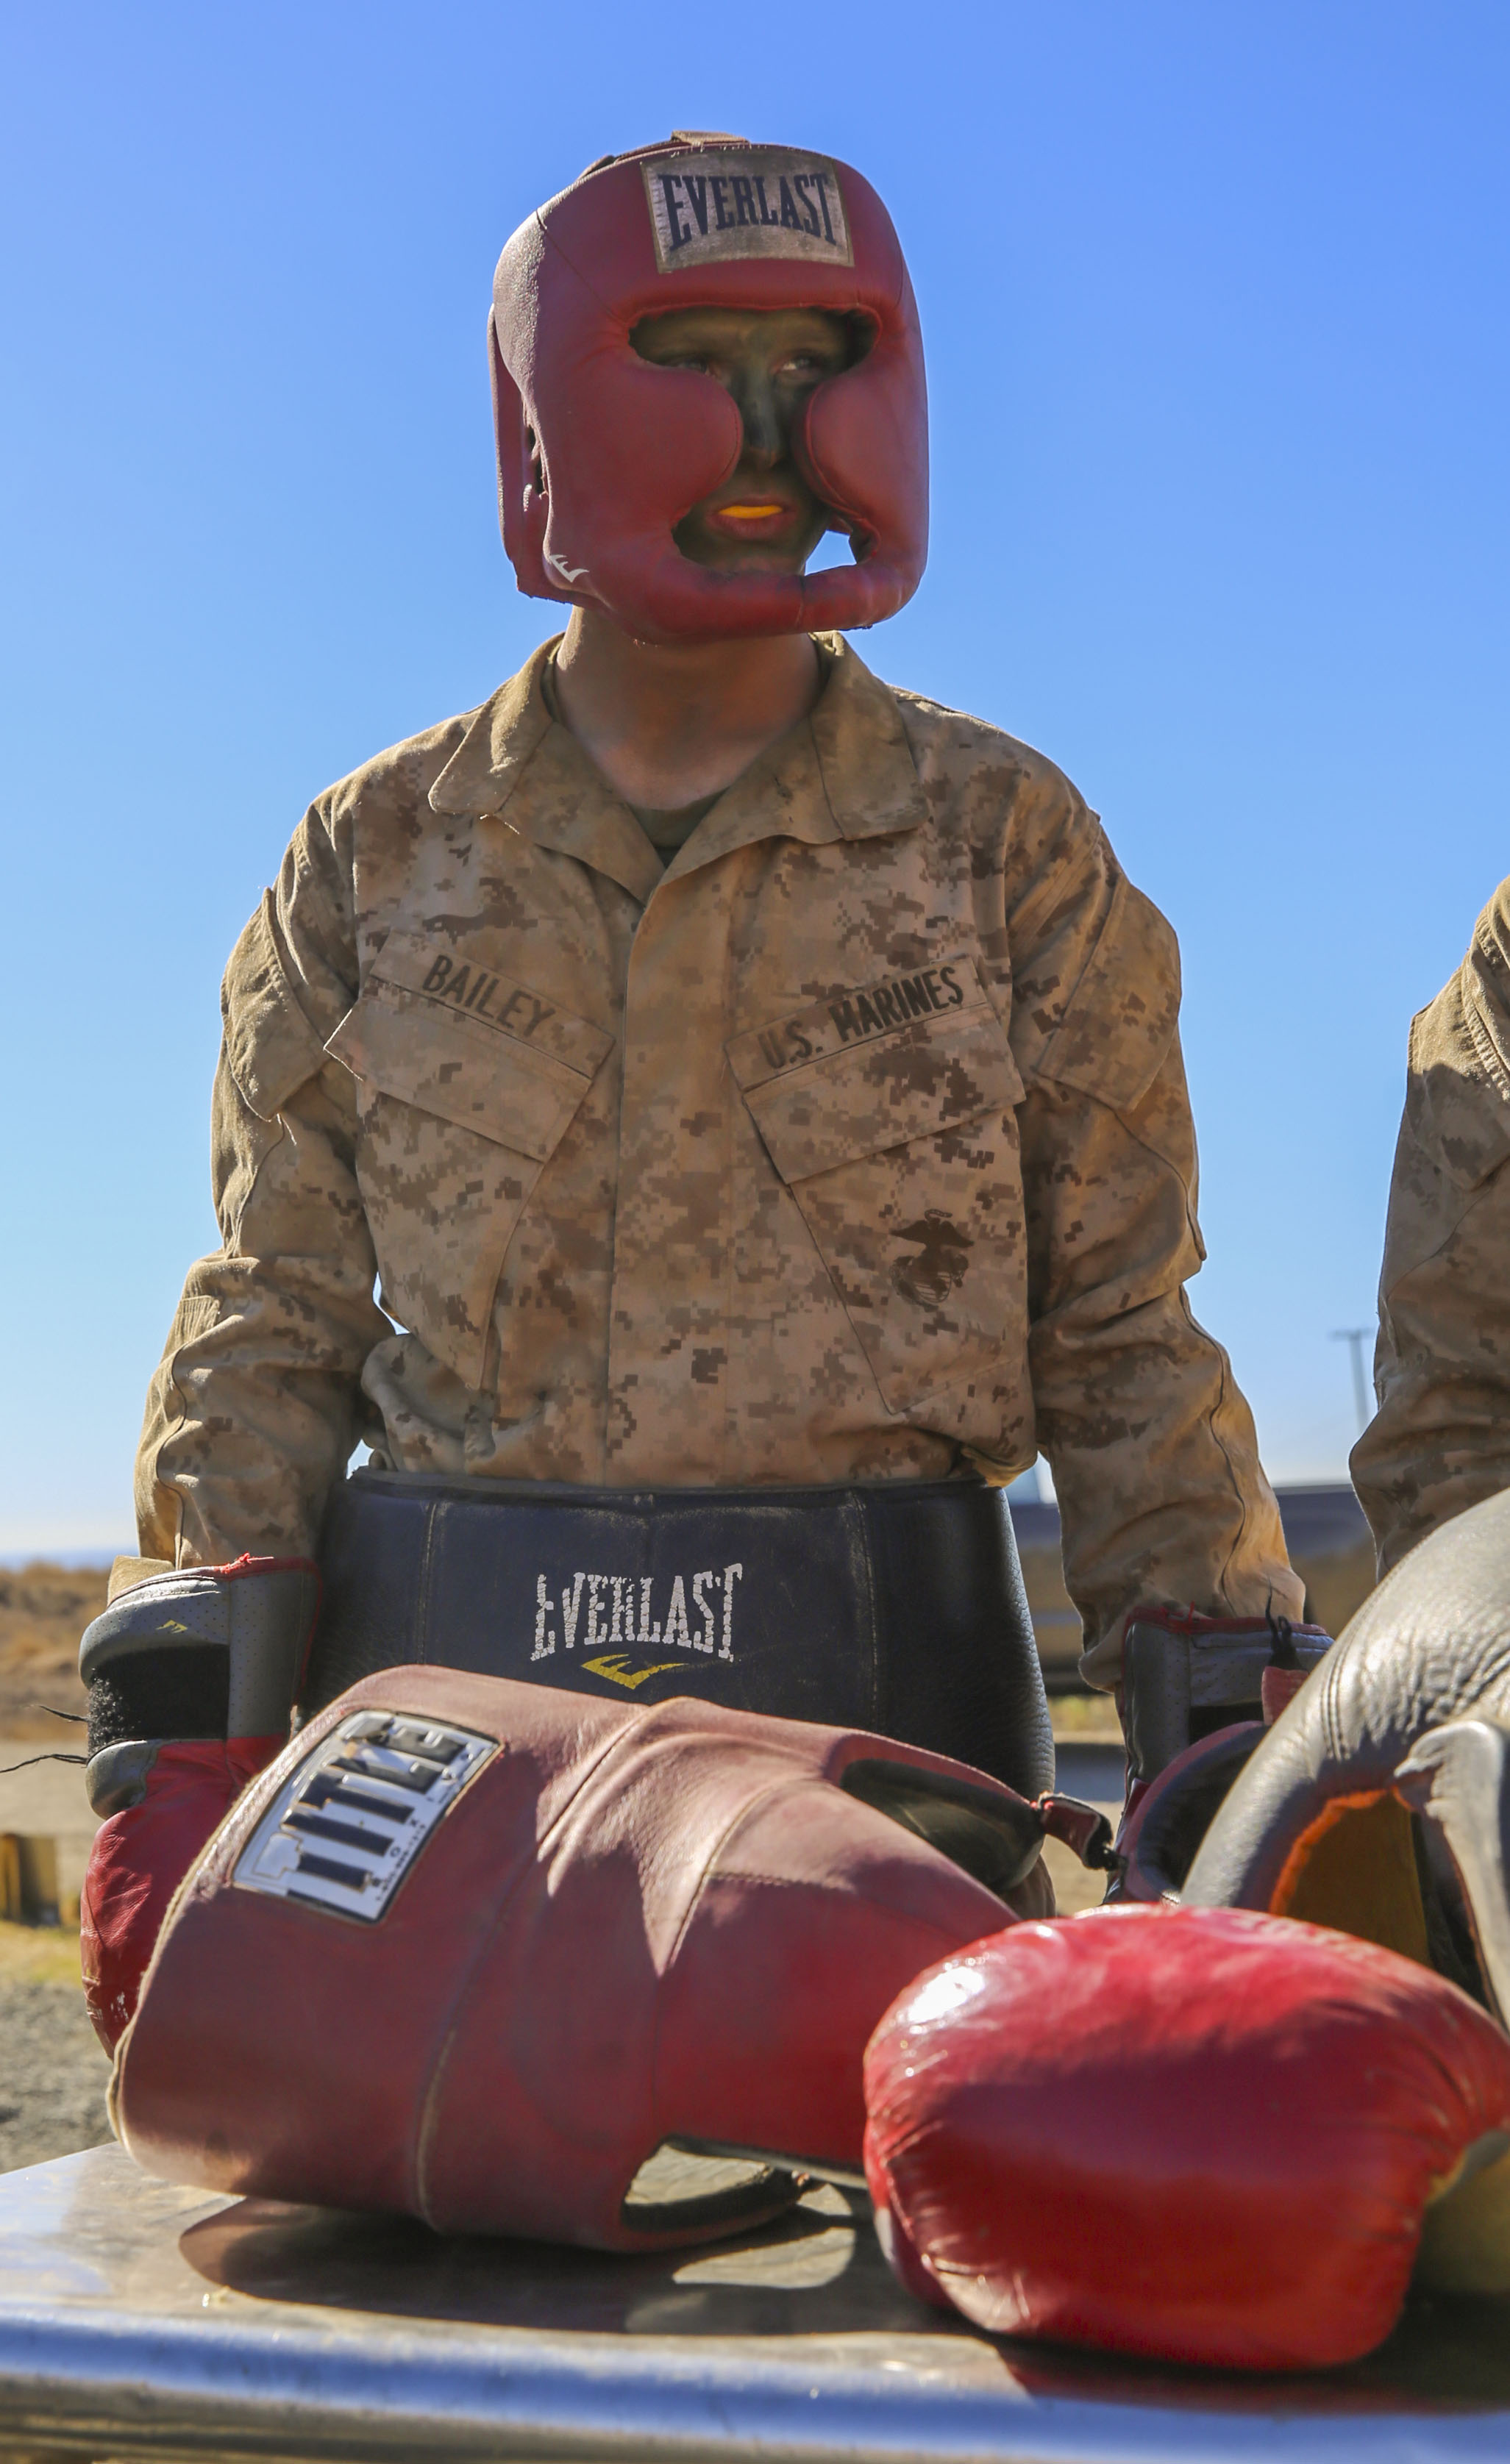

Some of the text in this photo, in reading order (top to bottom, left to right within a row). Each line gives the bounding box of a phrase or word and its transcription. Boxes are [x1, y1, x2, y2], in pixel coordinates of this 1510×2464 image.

[657, 172, 837, 251] EVERLAST
[422, 954, 556, 1038] BAILEY
[757, 966, 964, 1069] U.S. MARINES
[530, 1563, 743, 1663] EVERLAST
